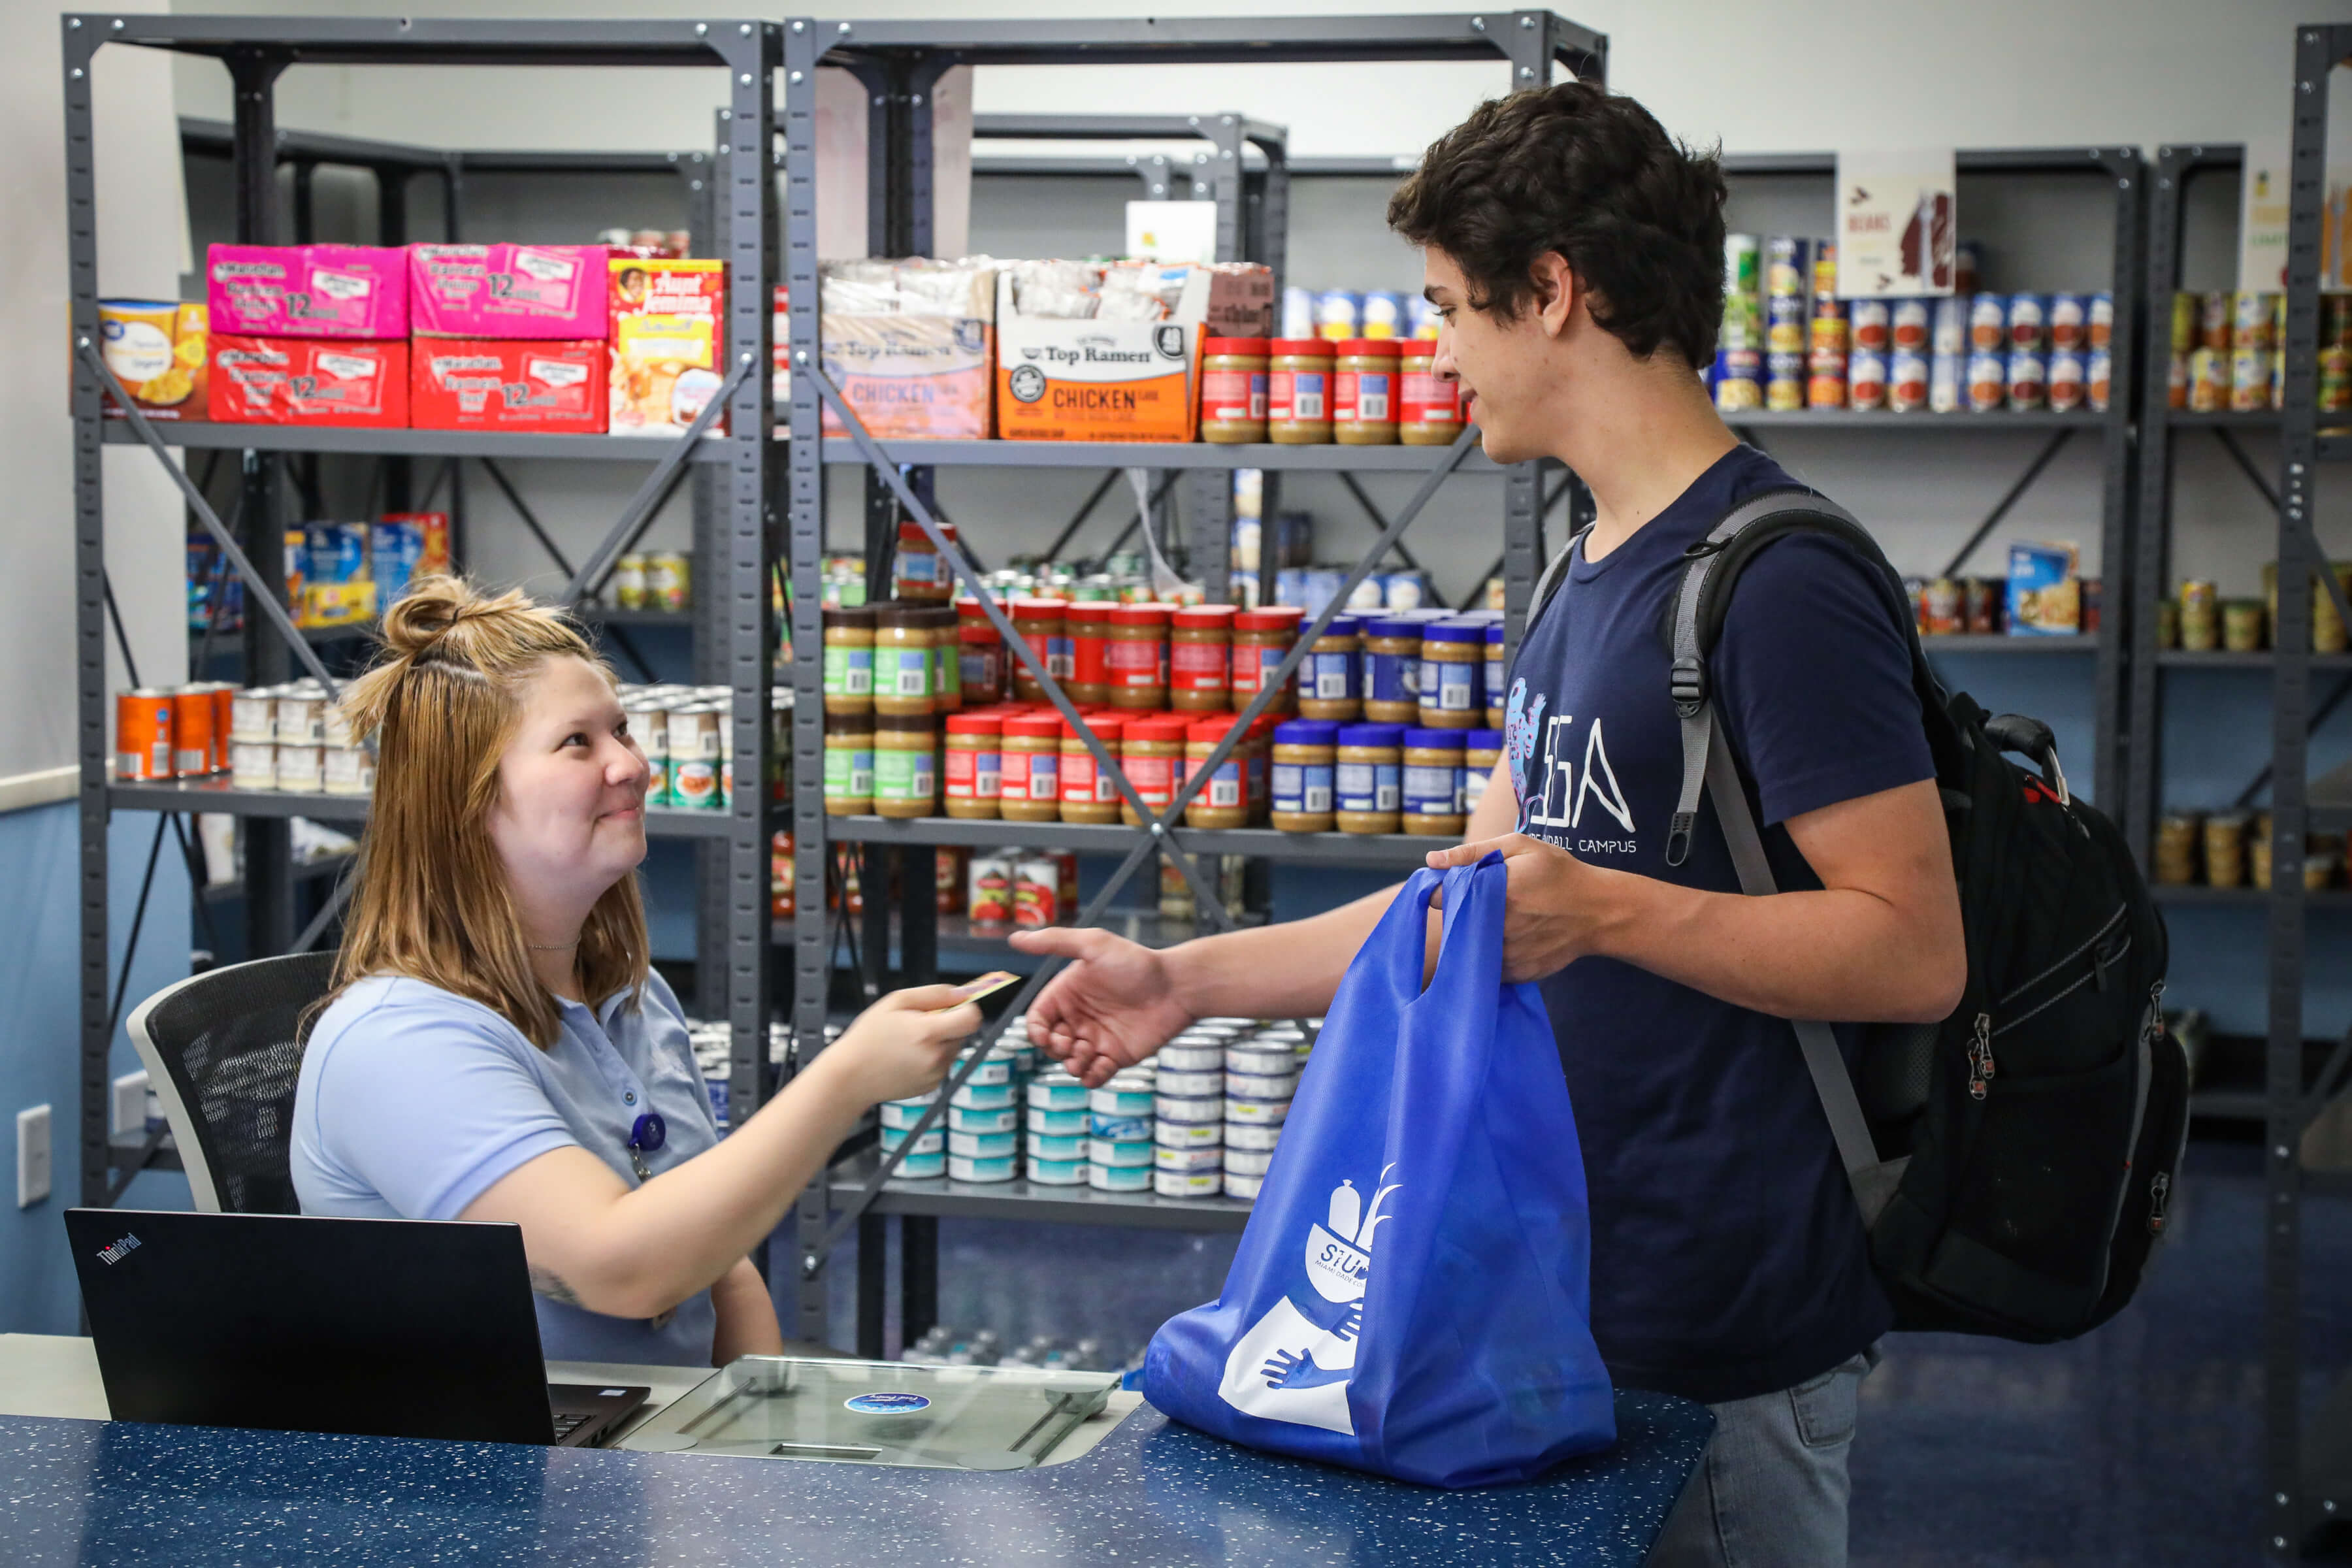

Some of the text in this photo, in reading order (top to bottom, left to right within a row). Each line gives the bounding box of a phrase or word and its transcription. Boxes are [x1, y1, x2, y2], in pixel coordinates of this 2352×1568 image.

[487, 273, 514, 298] 12
[284, 293, 311, 318] 12
[1045, 346, 1151, 366] Top Ramen
[289, 374, 318, 399] 12
[500, 383, 530, 407] 12
[852, 383, 936, 404] CHICKEN
[1053, 387, 1136, 409] CHICKEN
[1578, 840, 1637, 854] CAMPUS
[96, 1232, 142, 1266] ThinkPad
[1315, 1260, 1335, 1274] MIAMI
[1335, 1271, 1354, 1283] DADE
